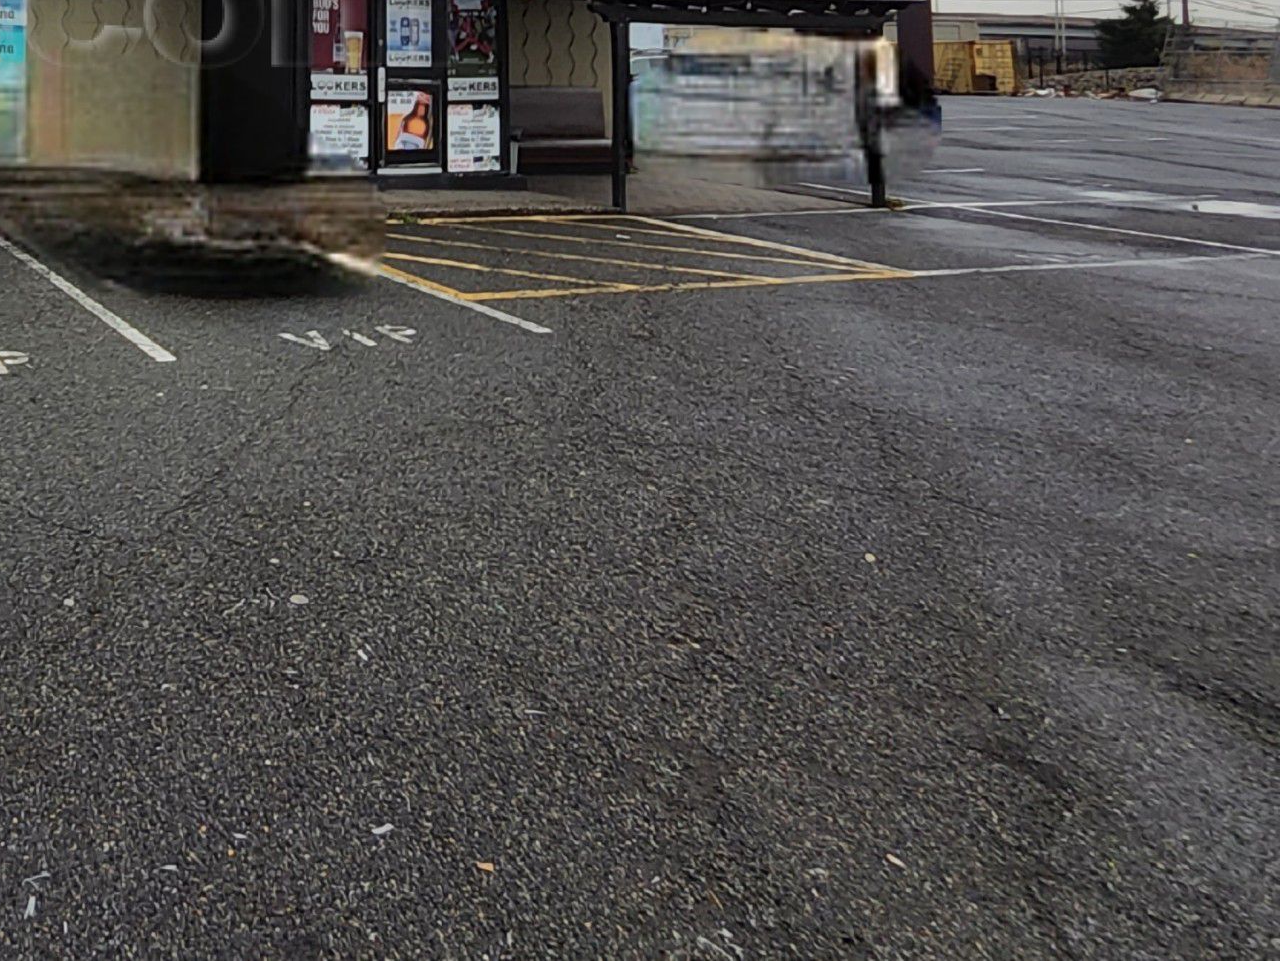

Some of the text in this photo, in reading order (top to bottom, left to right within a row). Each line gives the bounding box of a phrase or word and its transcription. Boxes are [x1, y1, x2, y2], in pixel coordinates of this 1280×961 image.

[312, 9, 329, 21] FOR
[312, 21, 329, 34] YOU
[275, 324, 417, 351] VIP
